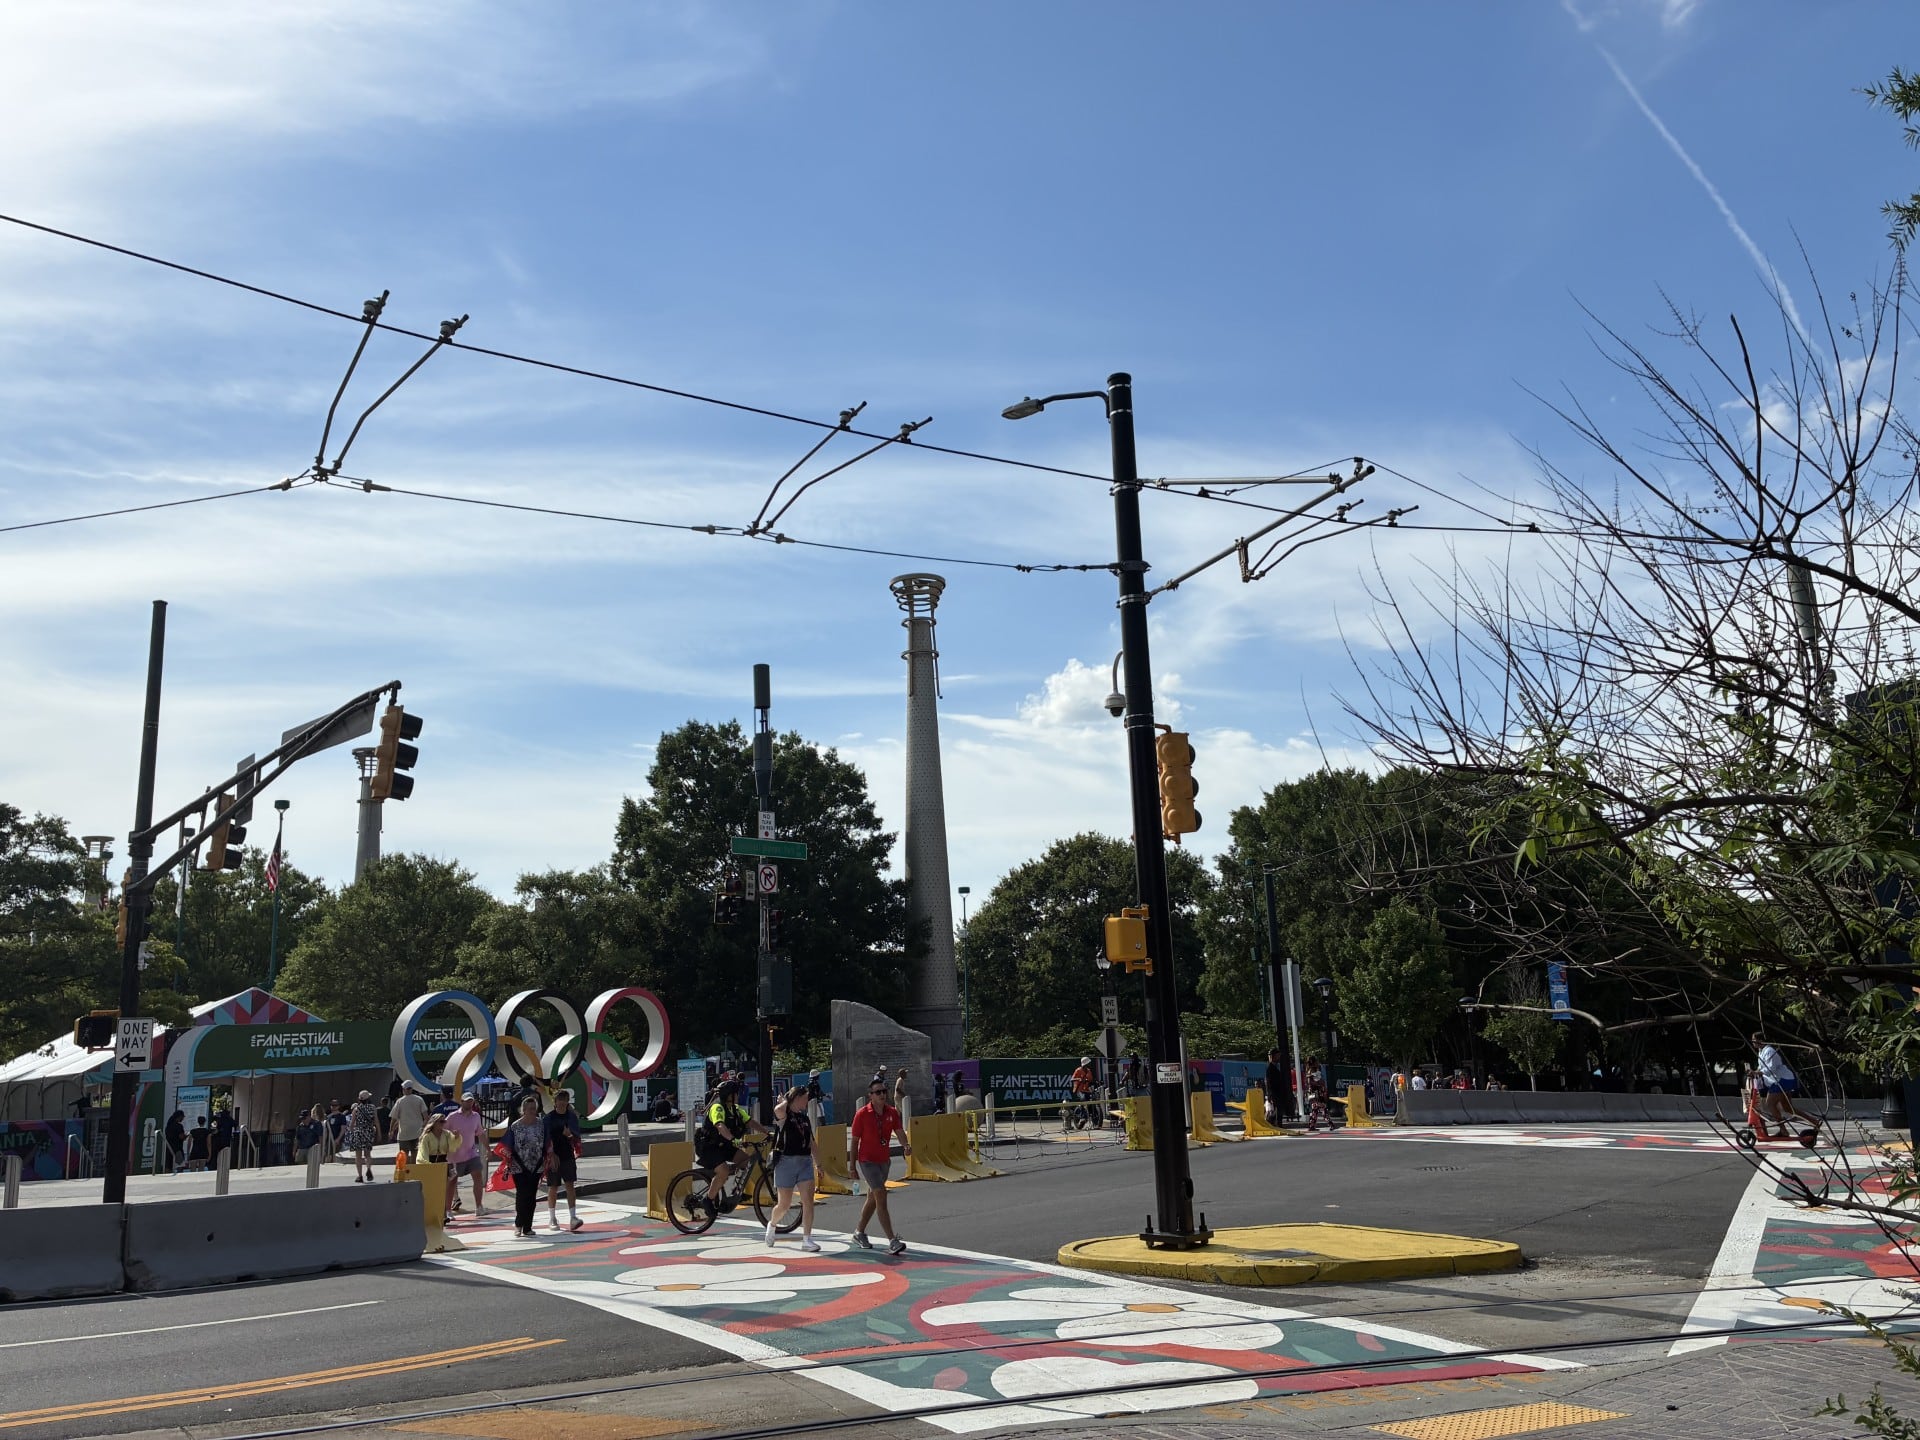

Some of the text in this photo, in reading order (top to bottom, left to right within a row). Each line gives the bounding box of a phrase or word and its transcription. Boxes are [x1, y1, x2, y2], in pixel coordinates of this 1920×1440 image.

[1104, 1007, 1116, 1015] WAY
[123, 1022, 149, 1035] ONE
[121, 1036, 147, 1049] WAY
[412, 1041, 467, 1052] ATLANT
[264, 1046, 331, 1058] ATLANTA
[634, 1086, 646, 1094] GATE
[1004, 1089, 1073, 1101] ATLANTA
